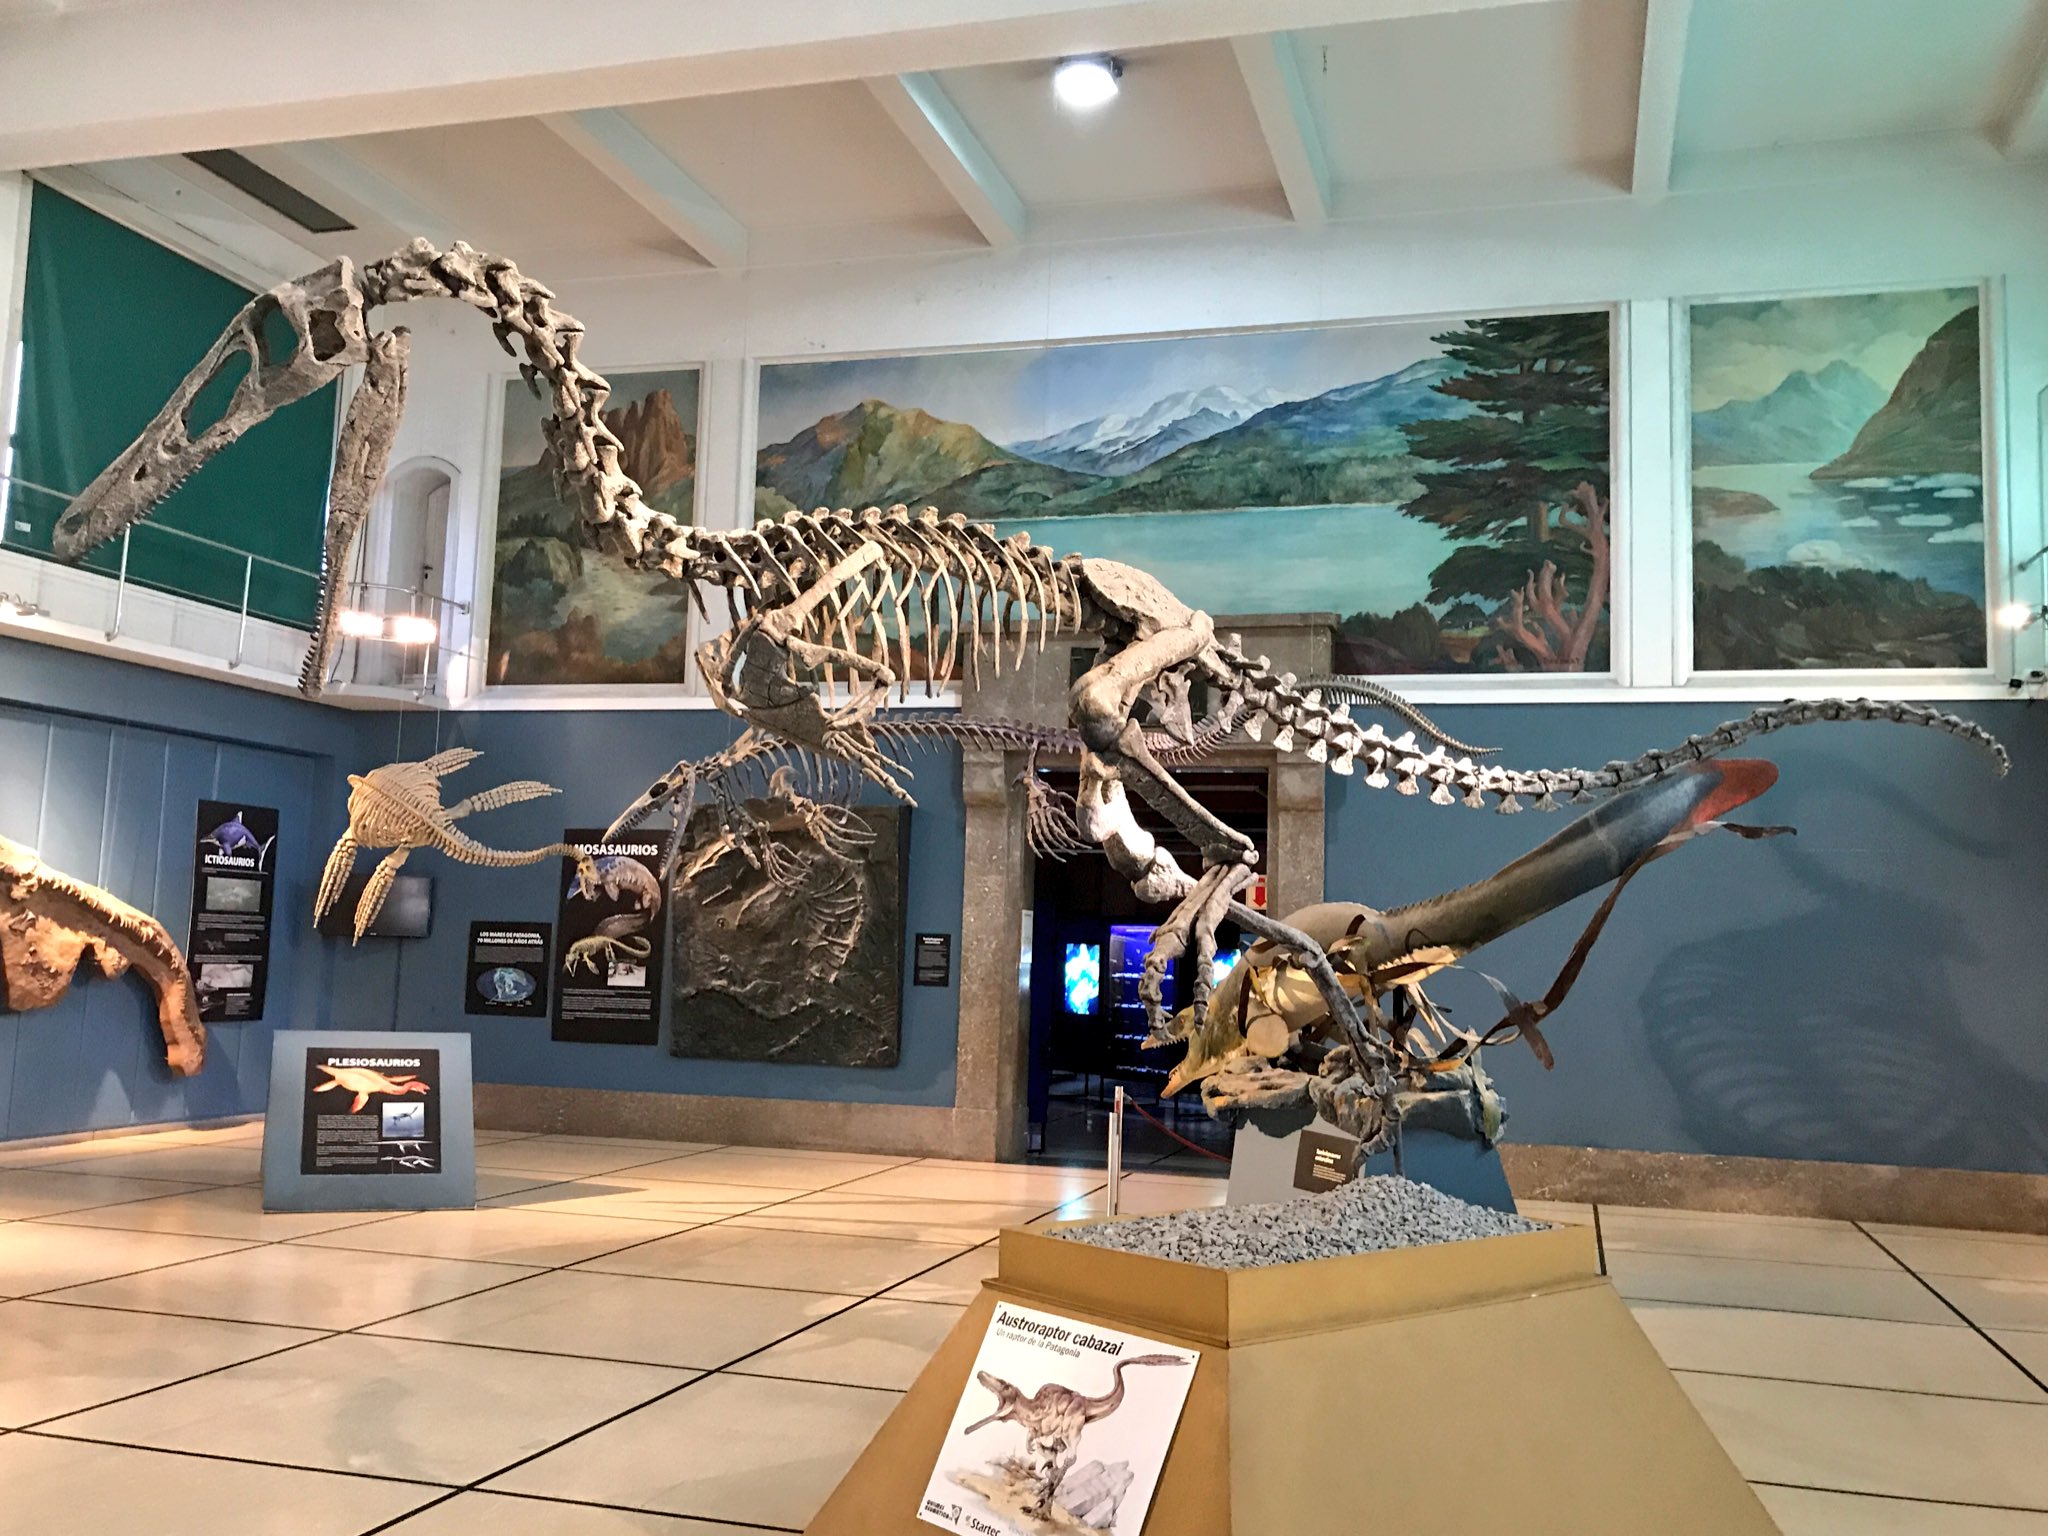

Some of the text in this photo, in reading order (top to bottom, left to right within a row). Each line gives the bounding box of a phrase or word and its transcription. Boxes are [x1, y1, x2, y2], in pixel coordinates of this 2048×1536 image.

[204, 853, 255, 868] ICTIOSAURIOS
[327, 1057, 421, 1068] PLESIOSAURIOS
[996, 1311, 1125, 1356] Austroraptor cabazai
[996, 1328, 1081, 1358] Un raptor de la Patagonia
